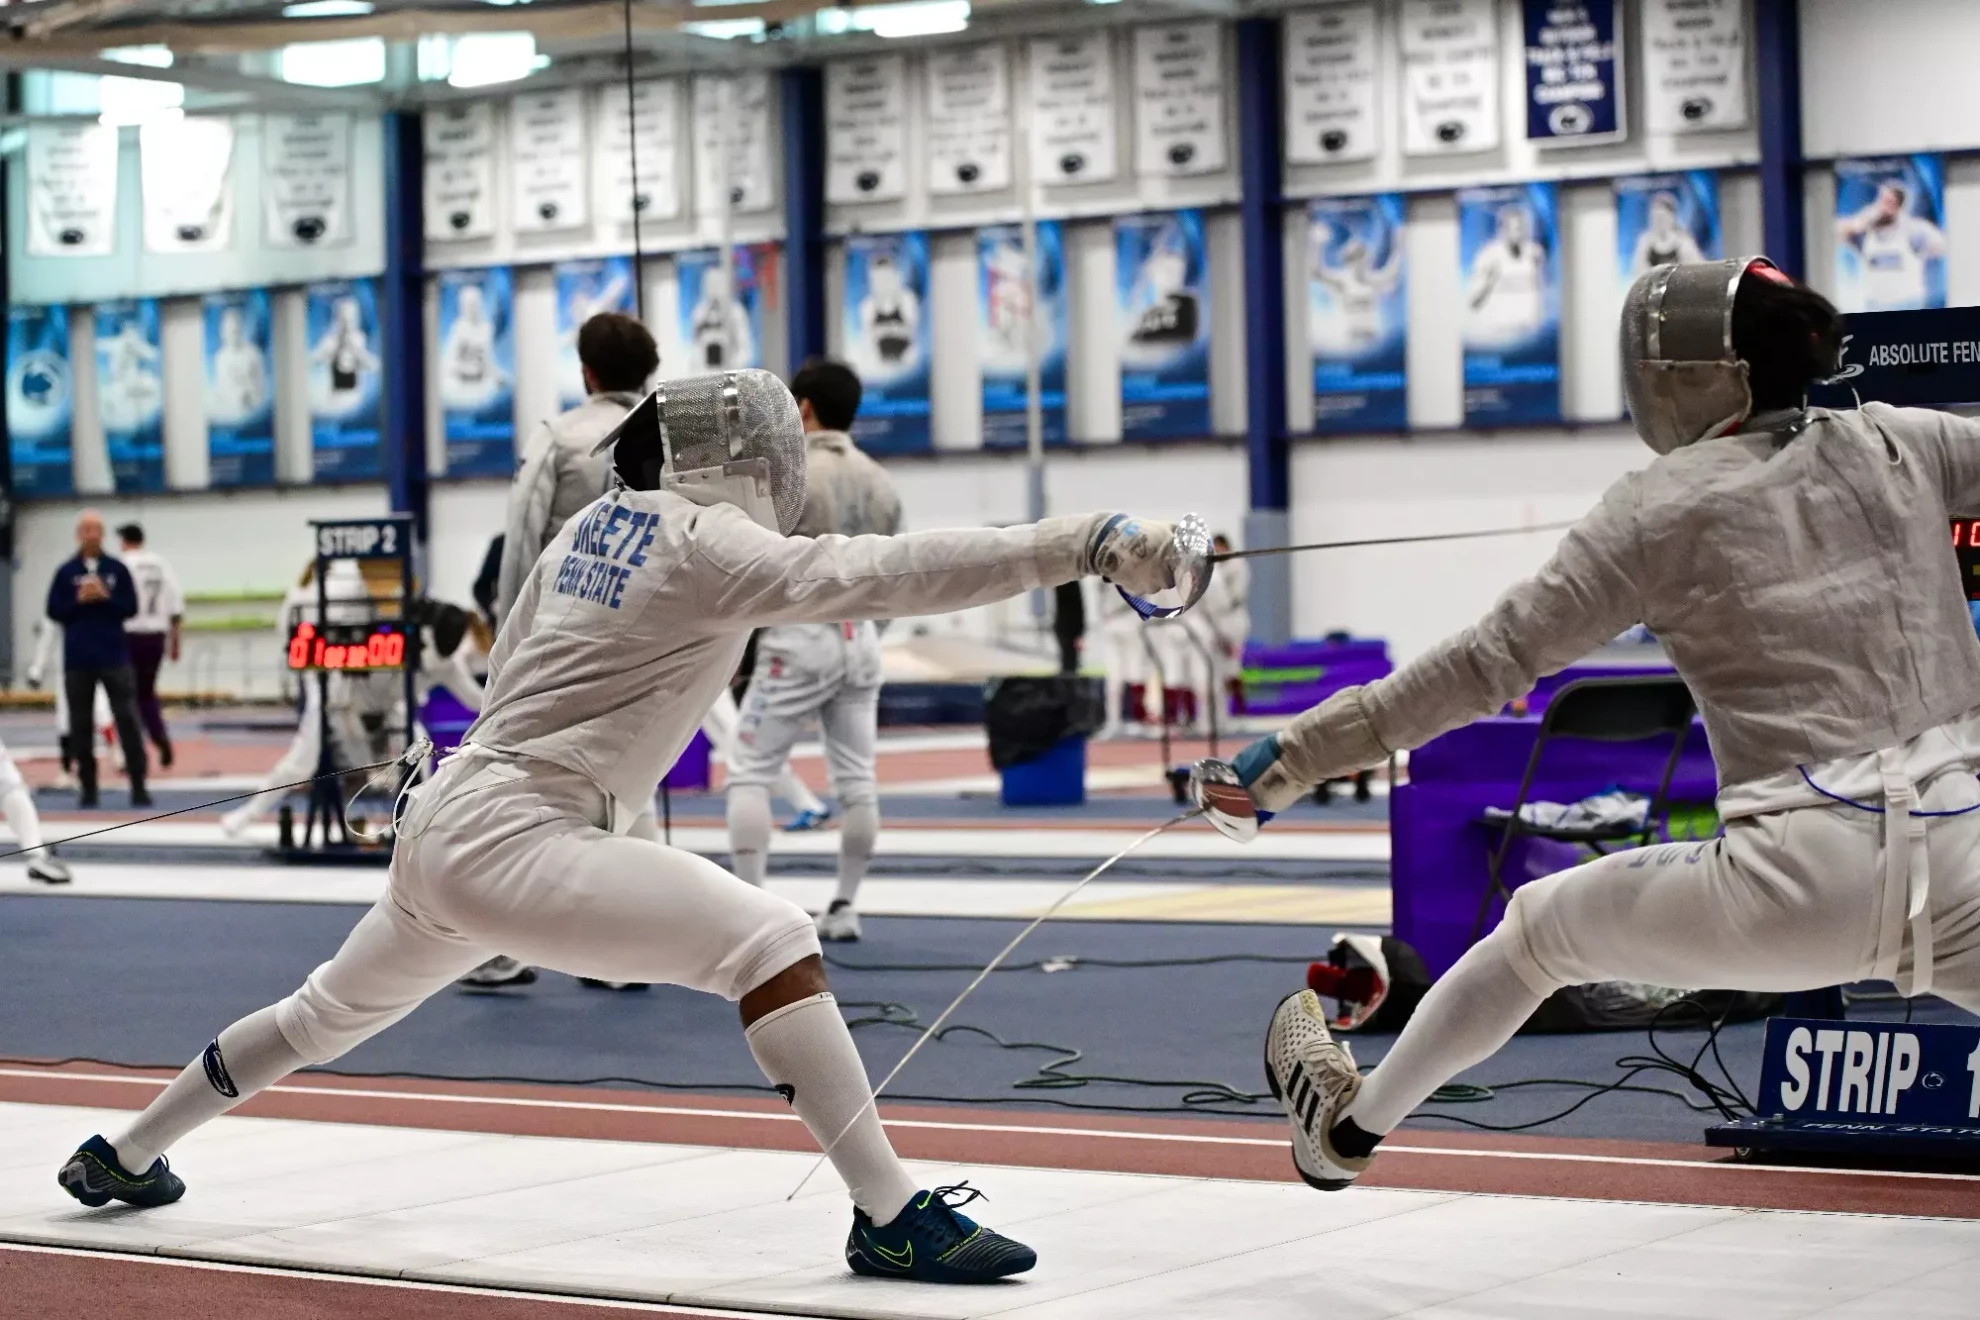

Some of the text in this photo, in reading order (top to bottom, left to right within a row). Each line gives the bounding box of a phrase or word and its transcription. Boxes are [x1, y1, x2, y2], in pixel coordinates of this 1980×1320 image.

[1869, 342, 1949, 366] ABSOLUTE
[320, 524, 397, 556] STRIP 2
[552, 555, 631, 609] PENN STATE
[1780, 1026, 1921, 1116] STRIP
[1801, 1122, 1886, 1132] PENN
